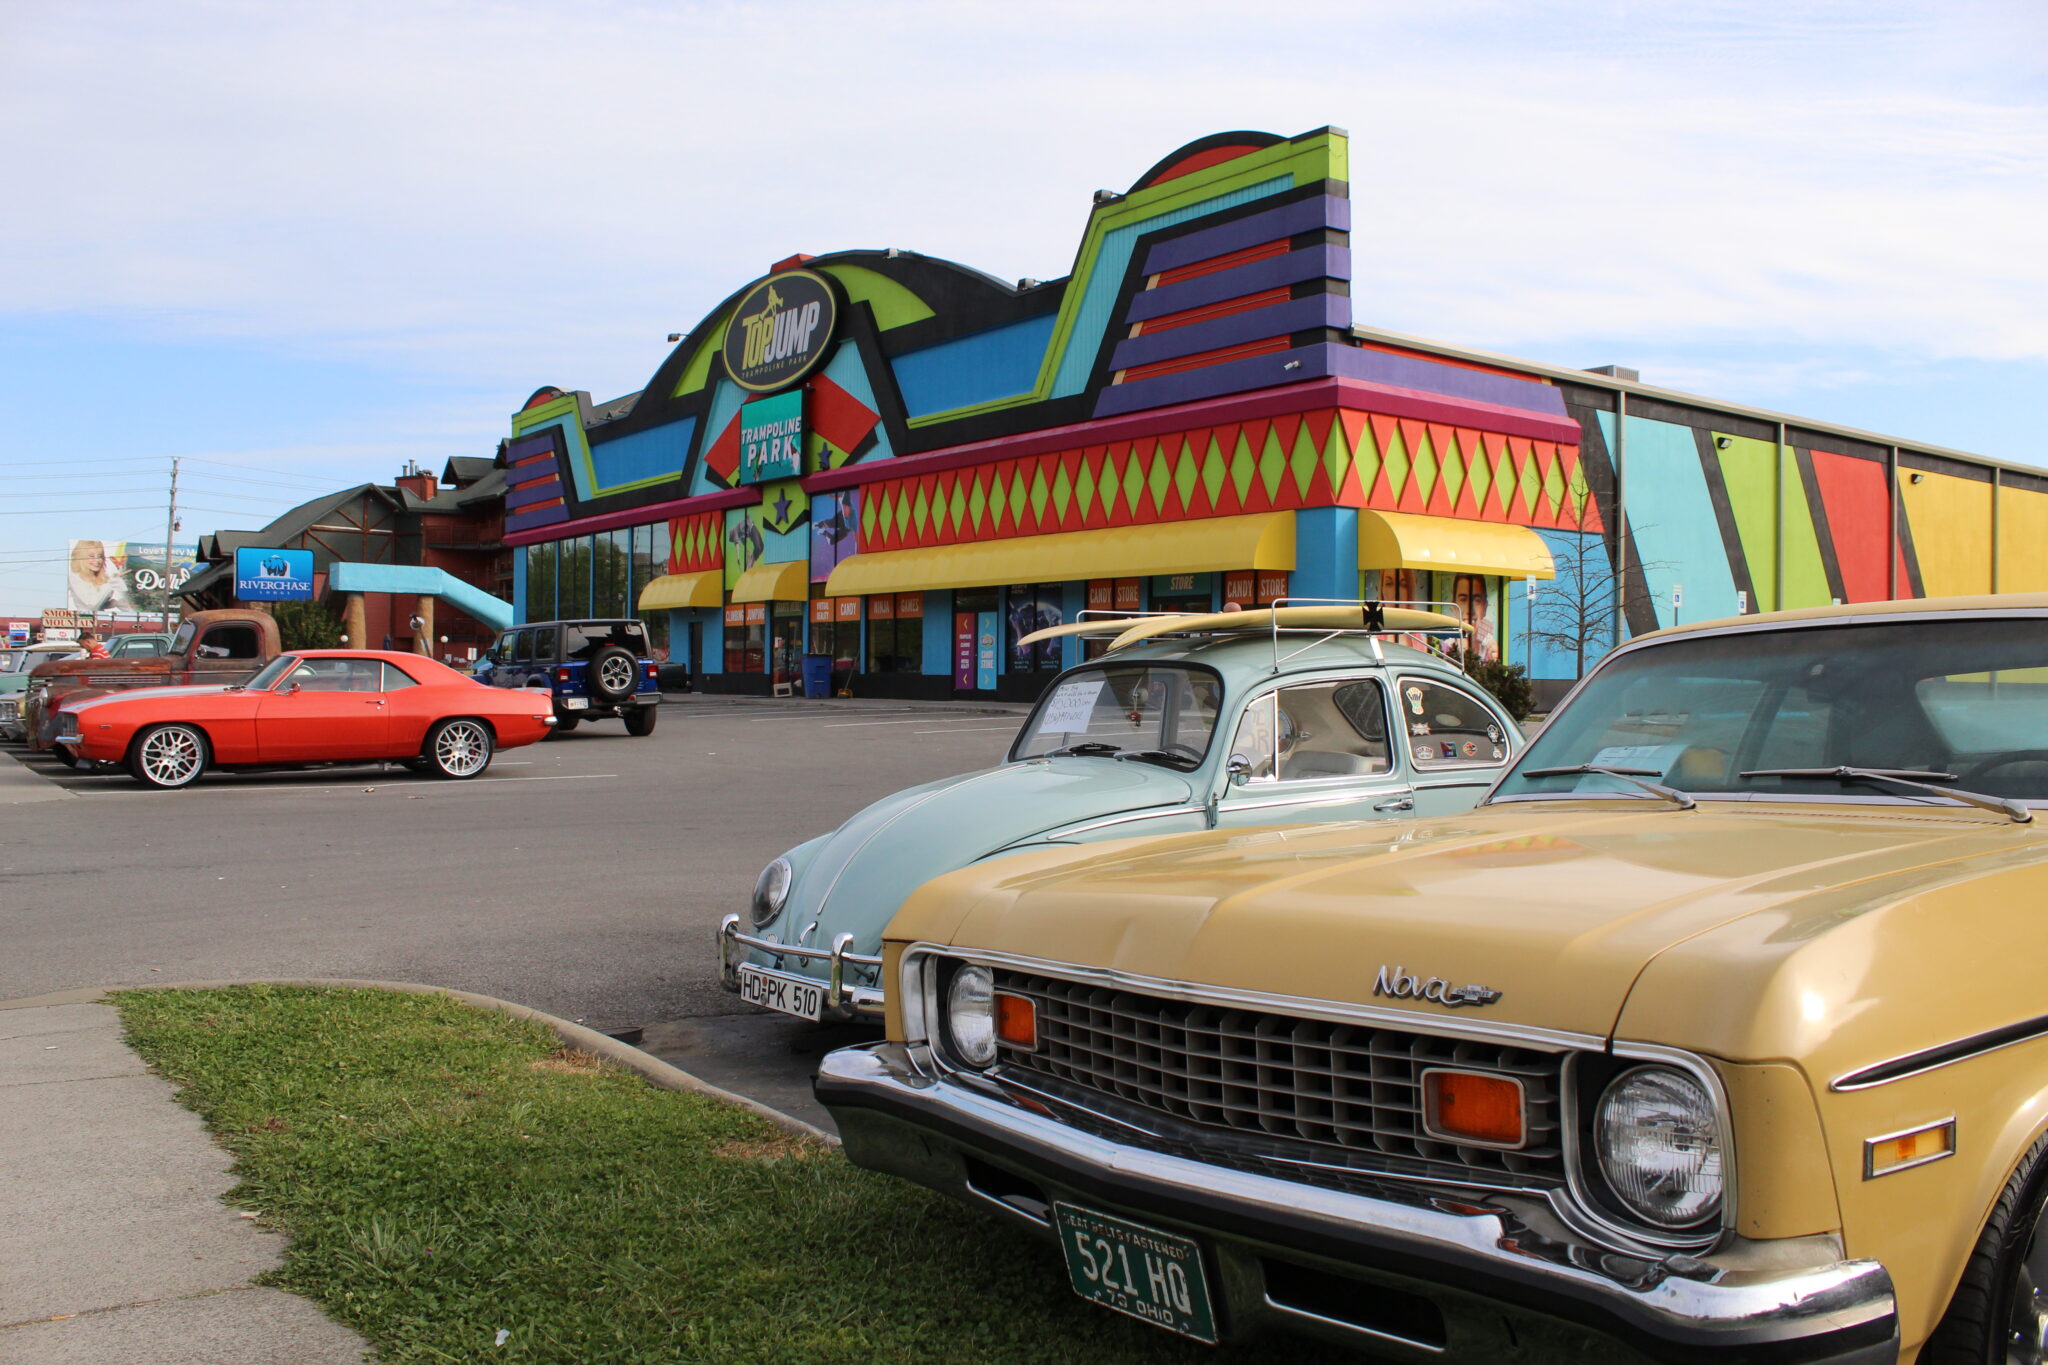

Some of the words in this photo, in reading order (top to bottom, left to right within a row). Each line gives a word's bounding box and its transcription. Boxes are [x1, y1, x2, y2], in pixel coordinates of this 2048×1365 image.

[742, 361, 784, 379] TRAMPOLINE
[788, 354, 807, 366] PARK
[742, 416, 801, 444] TRAMPOLINE
[747, 435, 793, 467] PARK
[239, 580, 311, 591] RIVERCHASE
[1170, 576, 1194, 590] STORE
[1227, 580, 1253, 598] CANDY
[1260, 578, 1285, 597] STORE
[1090, 585, 1112, 604] CANDY
[1117, 586, 1138, 602] STORE
[43, 607, 76, 618] SMOK
[747, 608, 765, 620] JUMPING
[841, 602, 856, 616] CANDY
[43, 618, 95, 627] MOUNAIN
[1373, 965, 1463, 1005] Nova
[793, 985, 818, 1016] 510
[1075, 1231, 1139, 1296] 521
[1145, 1253, 1192, 1316] HQ
[1136, 1300, 1174, 1324] OHIO
